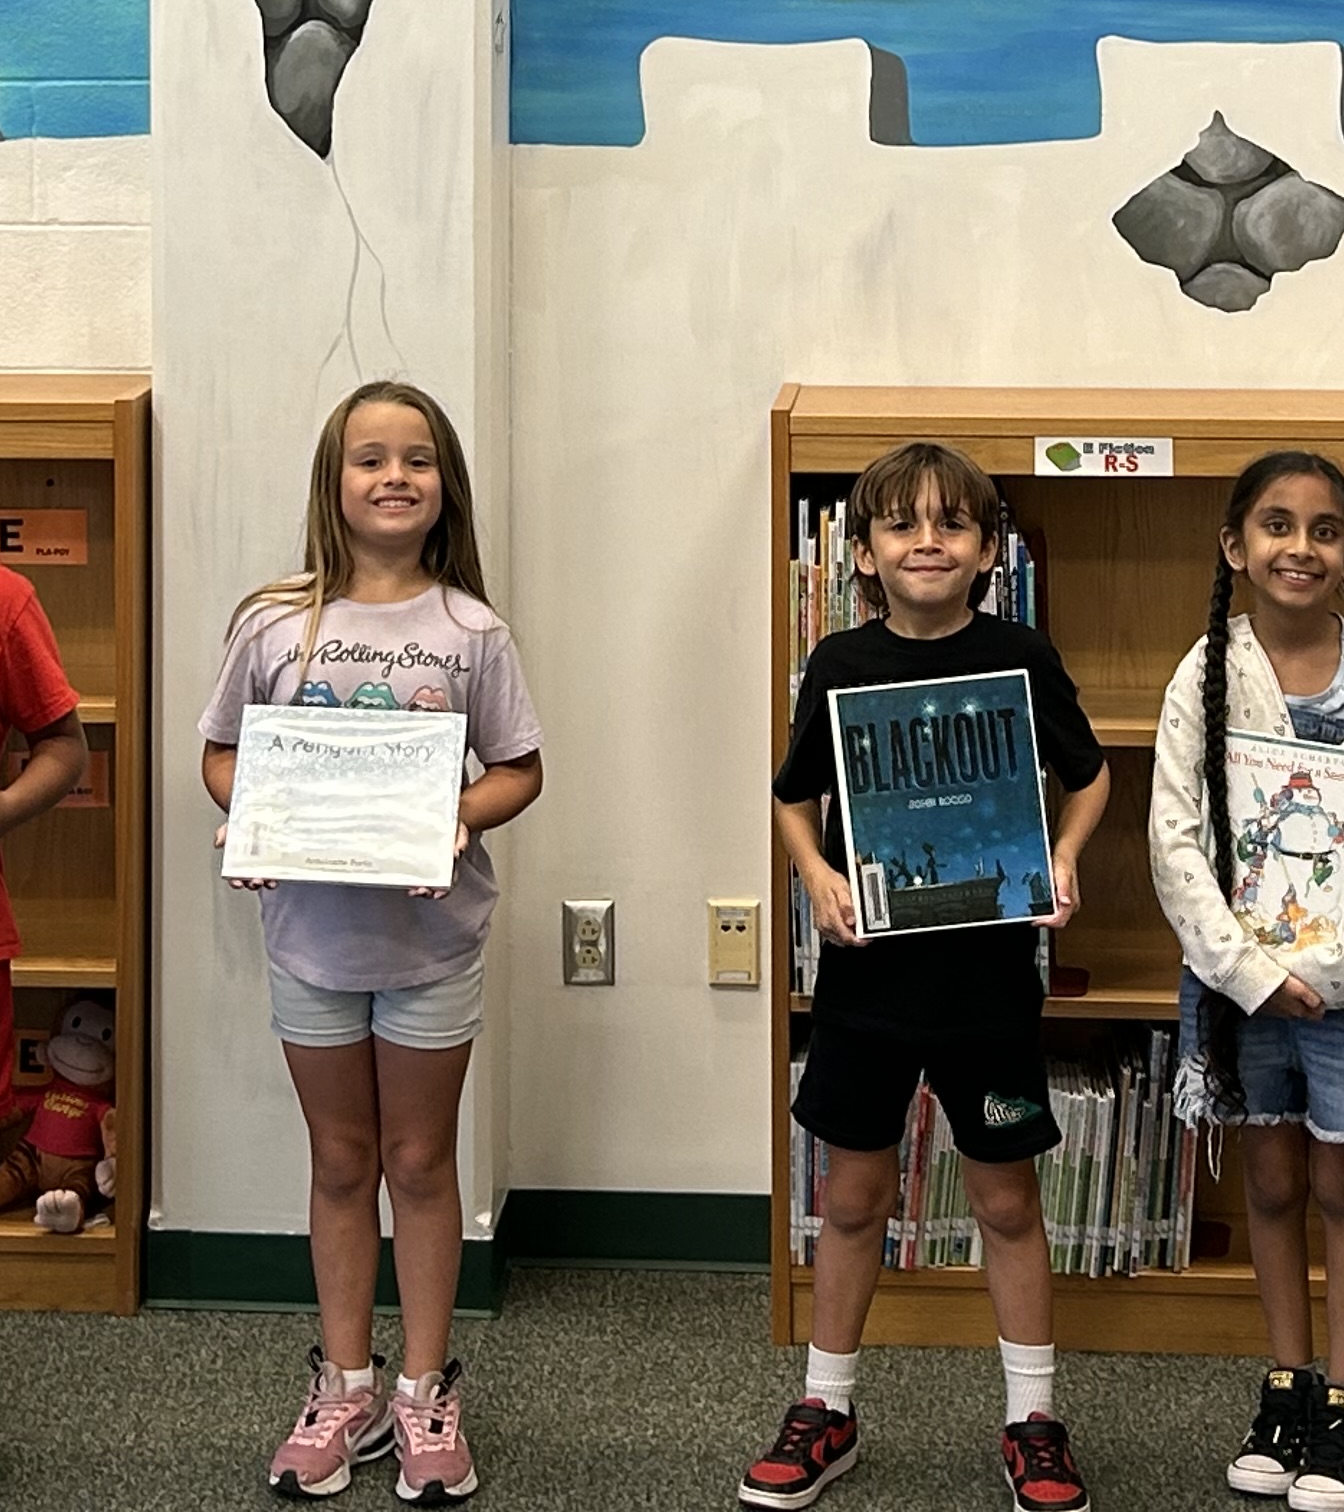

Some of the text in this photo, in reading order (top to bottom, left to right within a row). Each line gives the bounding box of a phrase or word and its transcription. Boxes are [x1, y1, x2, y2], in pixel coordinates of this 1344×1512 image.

[1099, 443, 1155, 454] Fiction
[1105, 454, 1139, 473] R-S
[0, 519, 24, 553] E
[277, 639, 470, 678] th Rolling Stones
[267, 734, 285, 752] A
[845, 707, 1018, 795] BLACKOUT
[1226, 751, 1241, 764] All
[1266, 757, 1295, 773] Need
[20, 1038, 44, 1074] E
